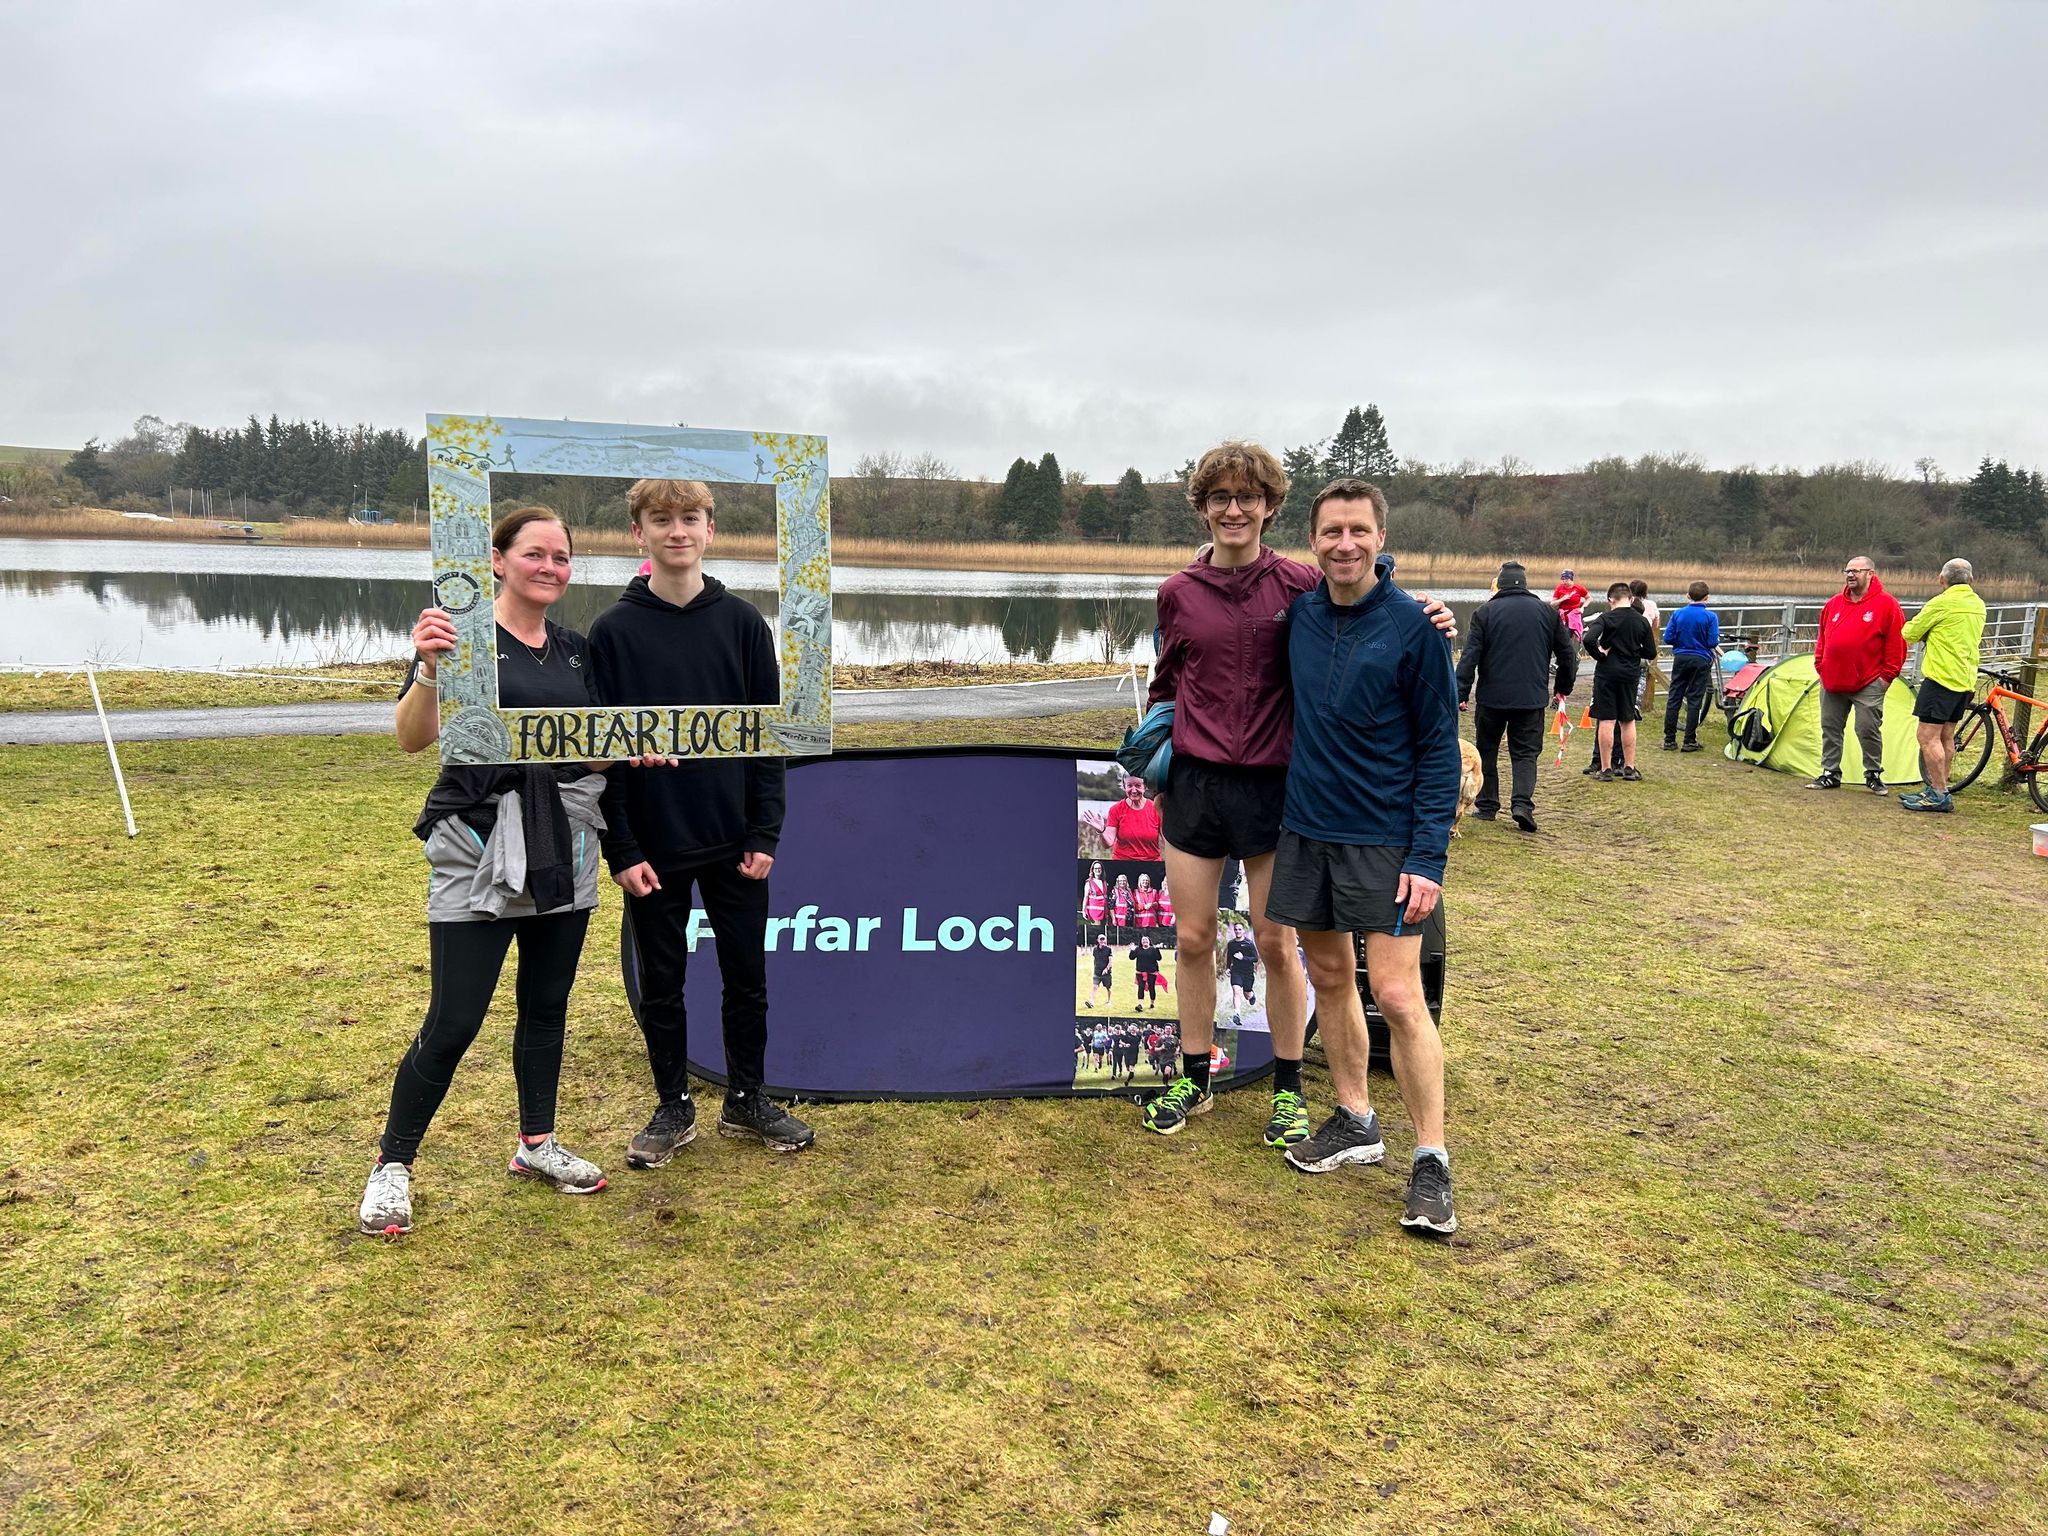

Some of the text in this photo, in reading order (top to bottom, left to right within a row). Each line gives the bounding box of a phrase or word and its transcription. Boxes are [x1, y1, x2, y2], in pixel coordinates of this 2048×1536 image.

[437, 453, 474, 470] Rotary
[1371, 641, 1387, 650] Rab
[516, 711, 664, 761] FORFAR
[667, 708, 765, 756] LOCH
[685, 905, 1054, 952] Frfar Loch
